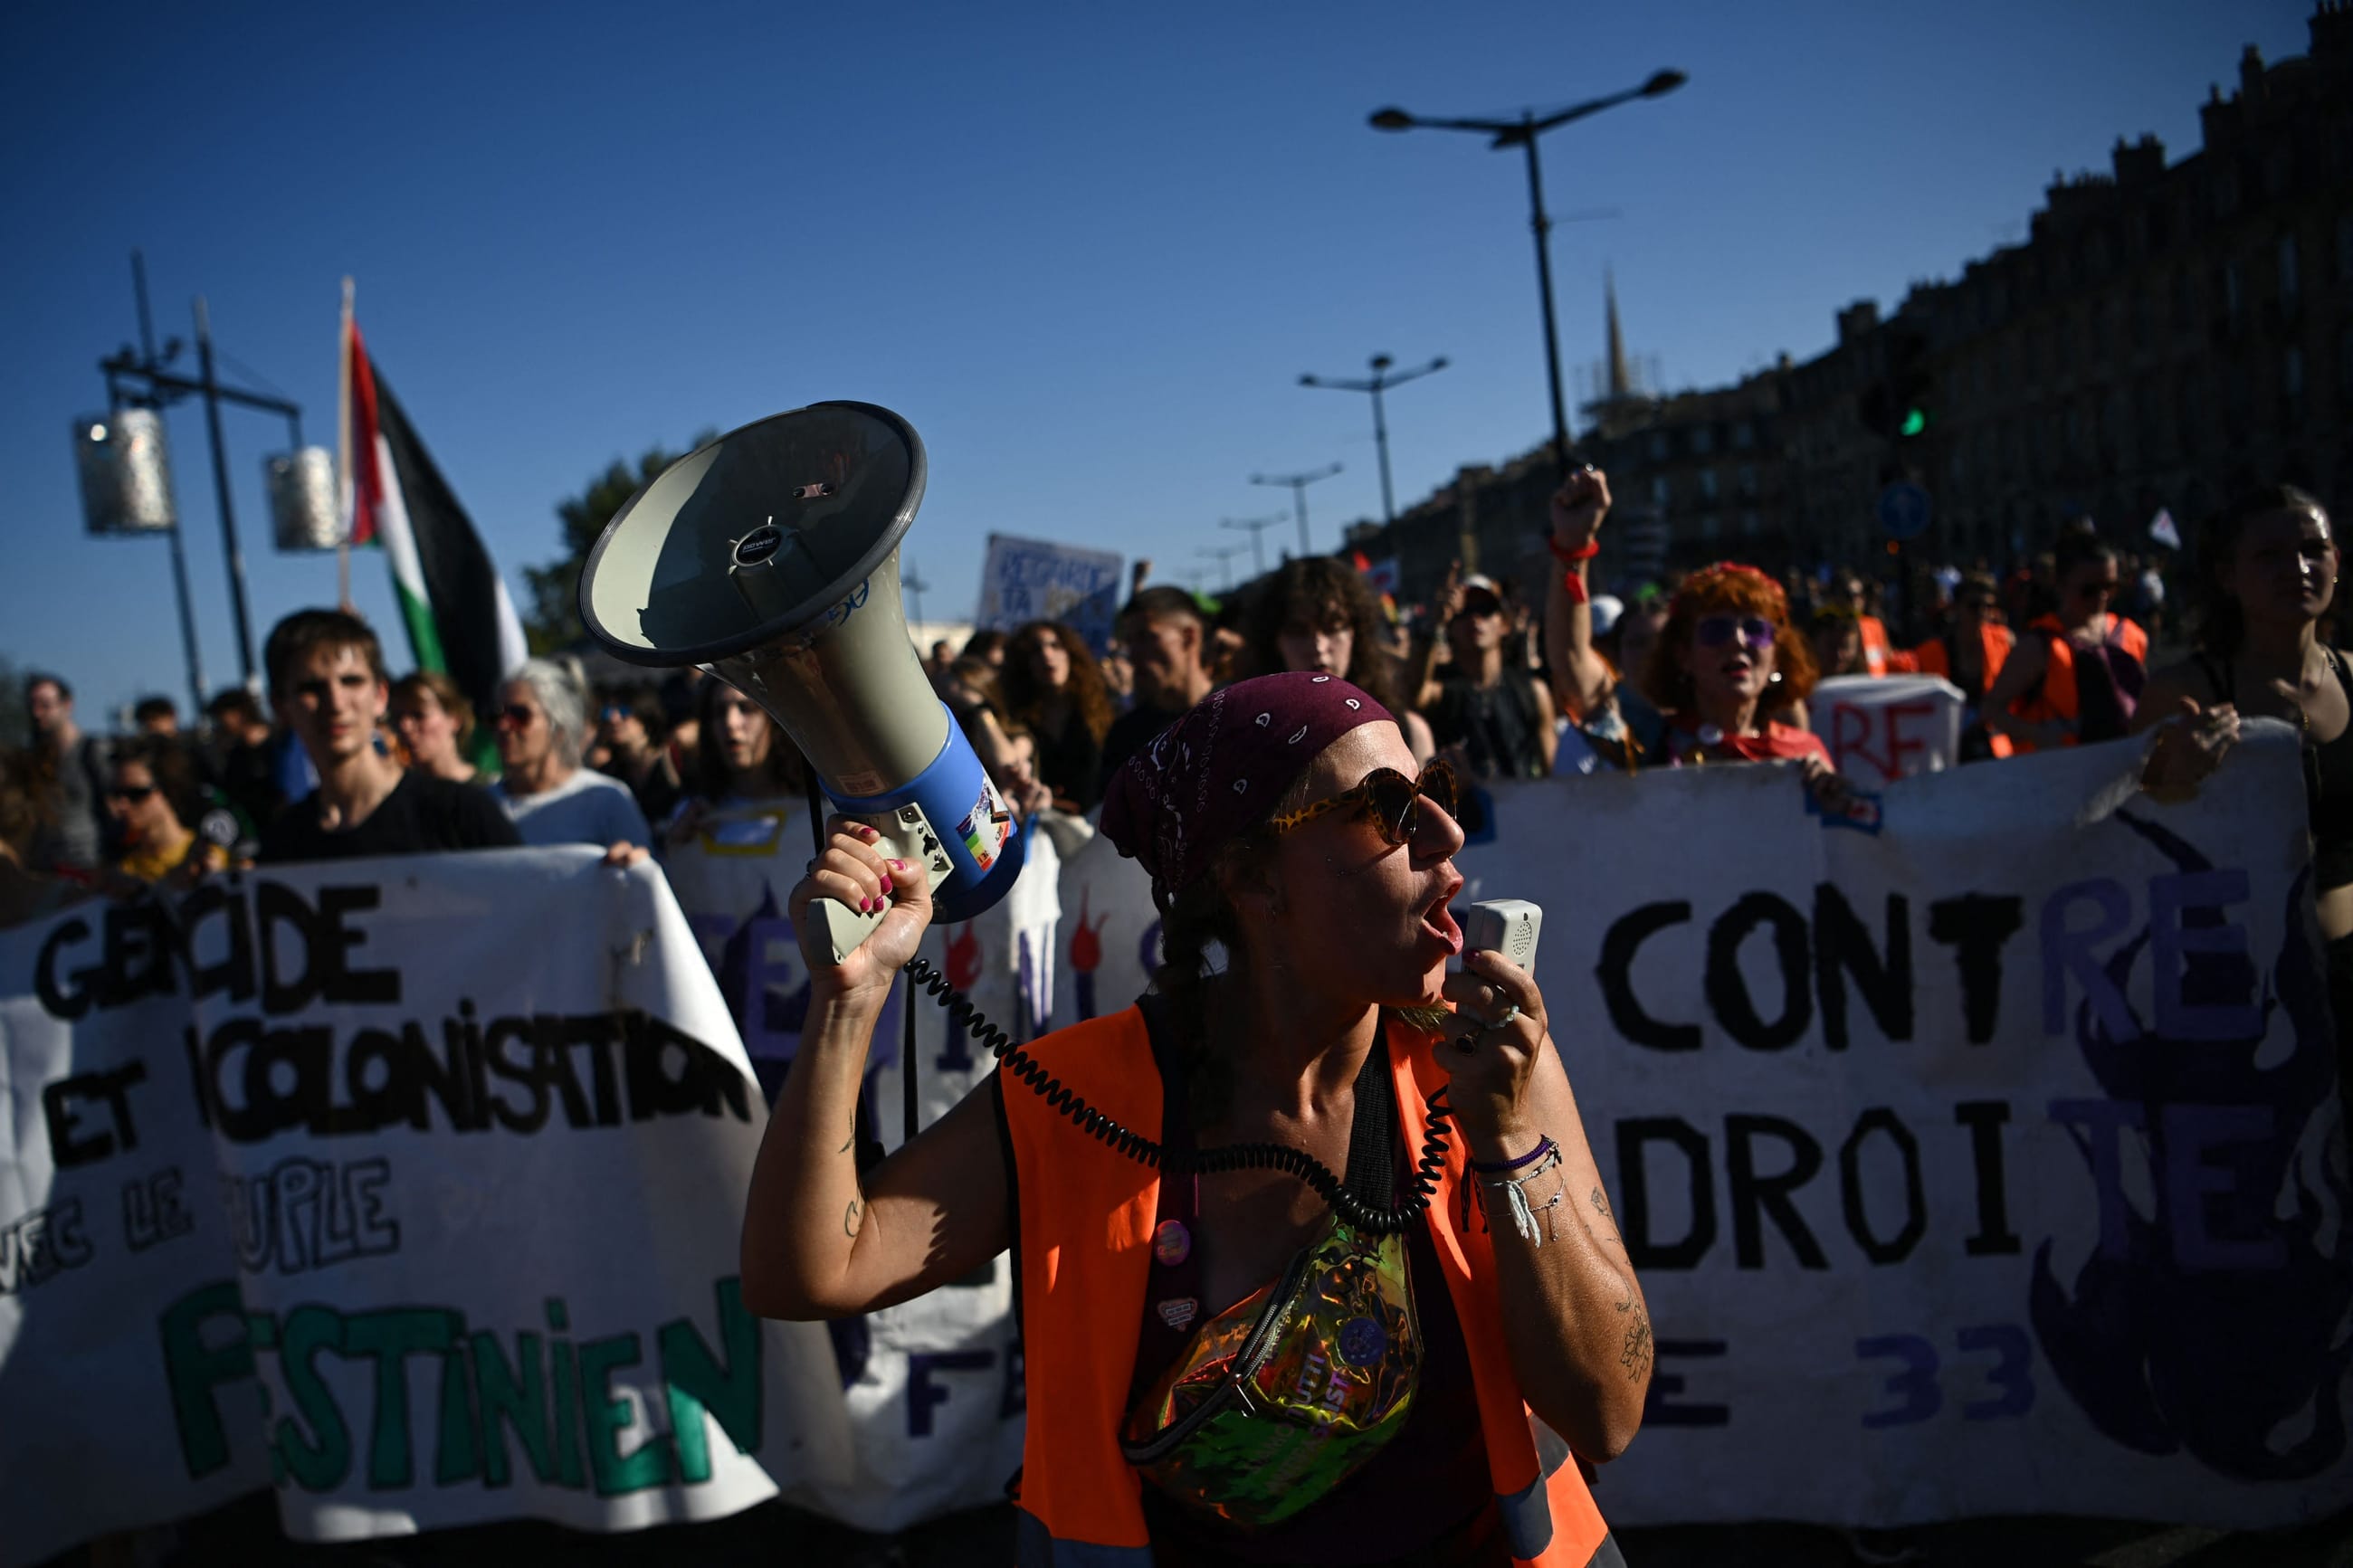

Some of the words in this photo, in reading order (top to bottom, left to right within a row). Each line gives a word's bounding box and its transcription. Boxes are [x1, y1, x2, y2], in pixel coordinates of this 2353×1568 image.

[1595, 868, 2266, 1053] CONTRE
[43, 1060, 146, 1166] ET
[1615, 1098, 2291, 1271] DROITE
[1855, 1324, 2036, 1430] 33
